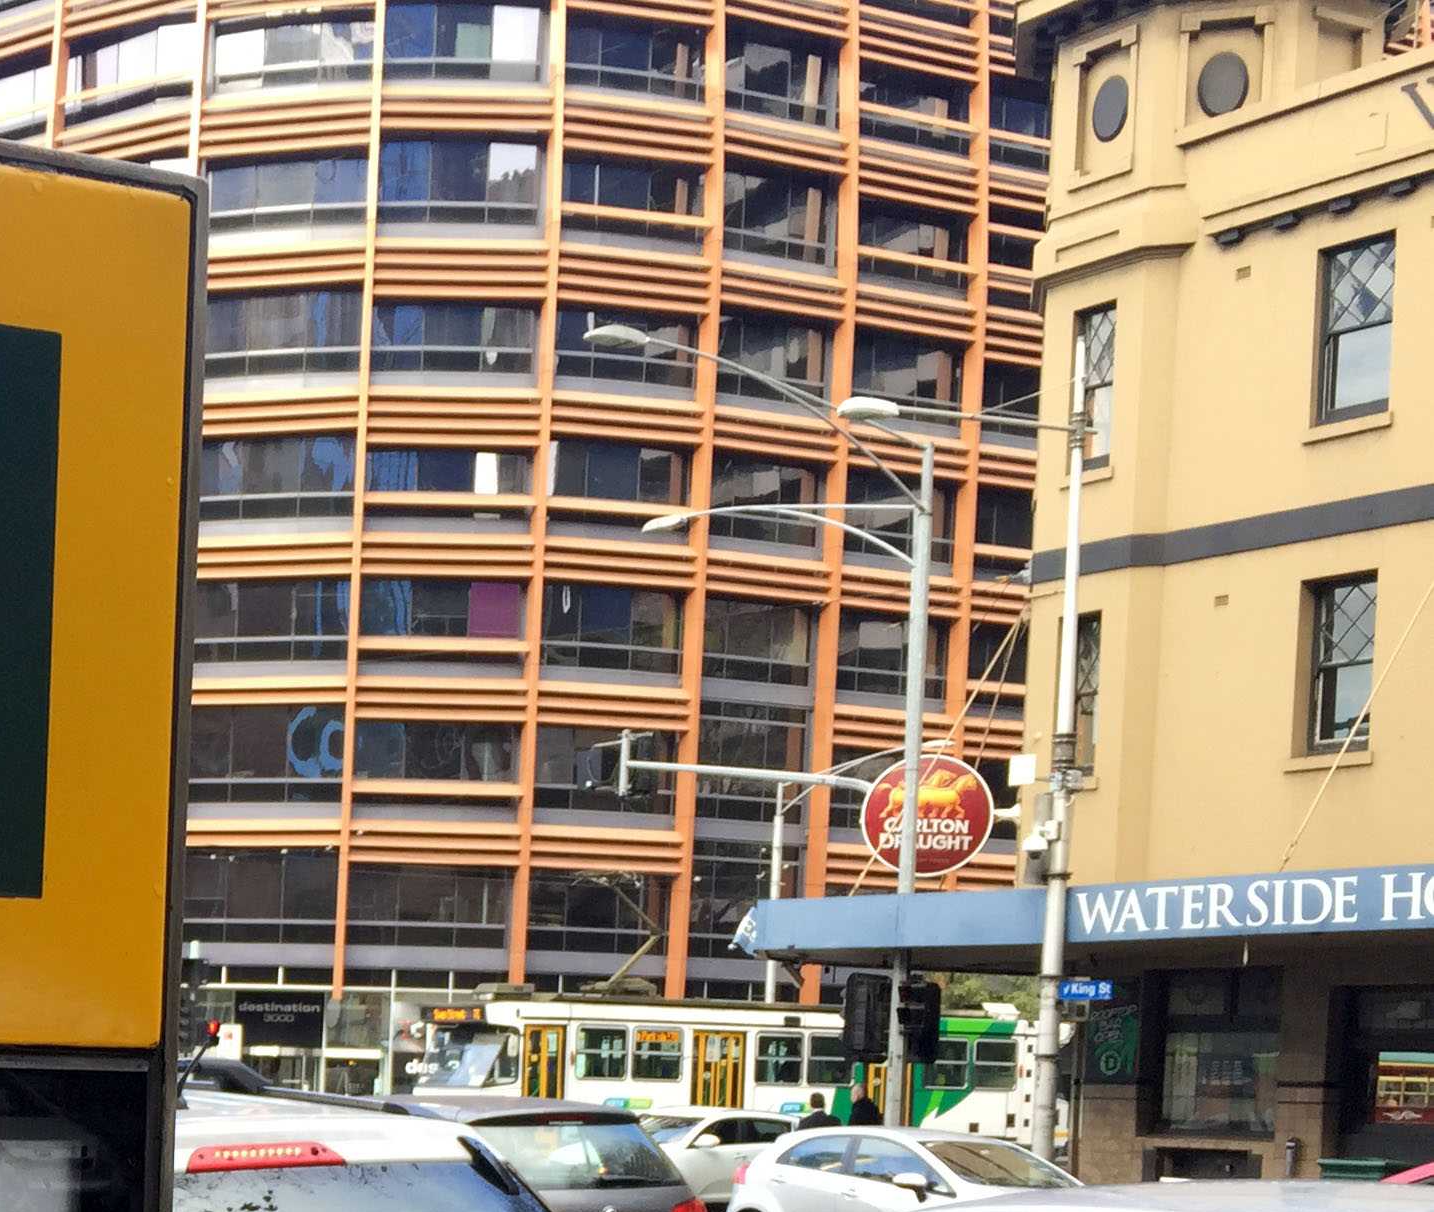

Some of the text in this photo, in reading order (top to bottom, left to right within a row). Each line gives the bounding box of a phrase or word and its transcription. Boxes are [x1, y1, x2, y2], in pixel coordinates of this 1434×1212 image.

[878, 832, 973, 850] DRUGHT
[1076, 875, 1358, 935] WATERSIDE
[1071, 982, 1096, 997] King
[1098, 981, 1112, 994] St
[238, 1001, 321, 1013] destination
